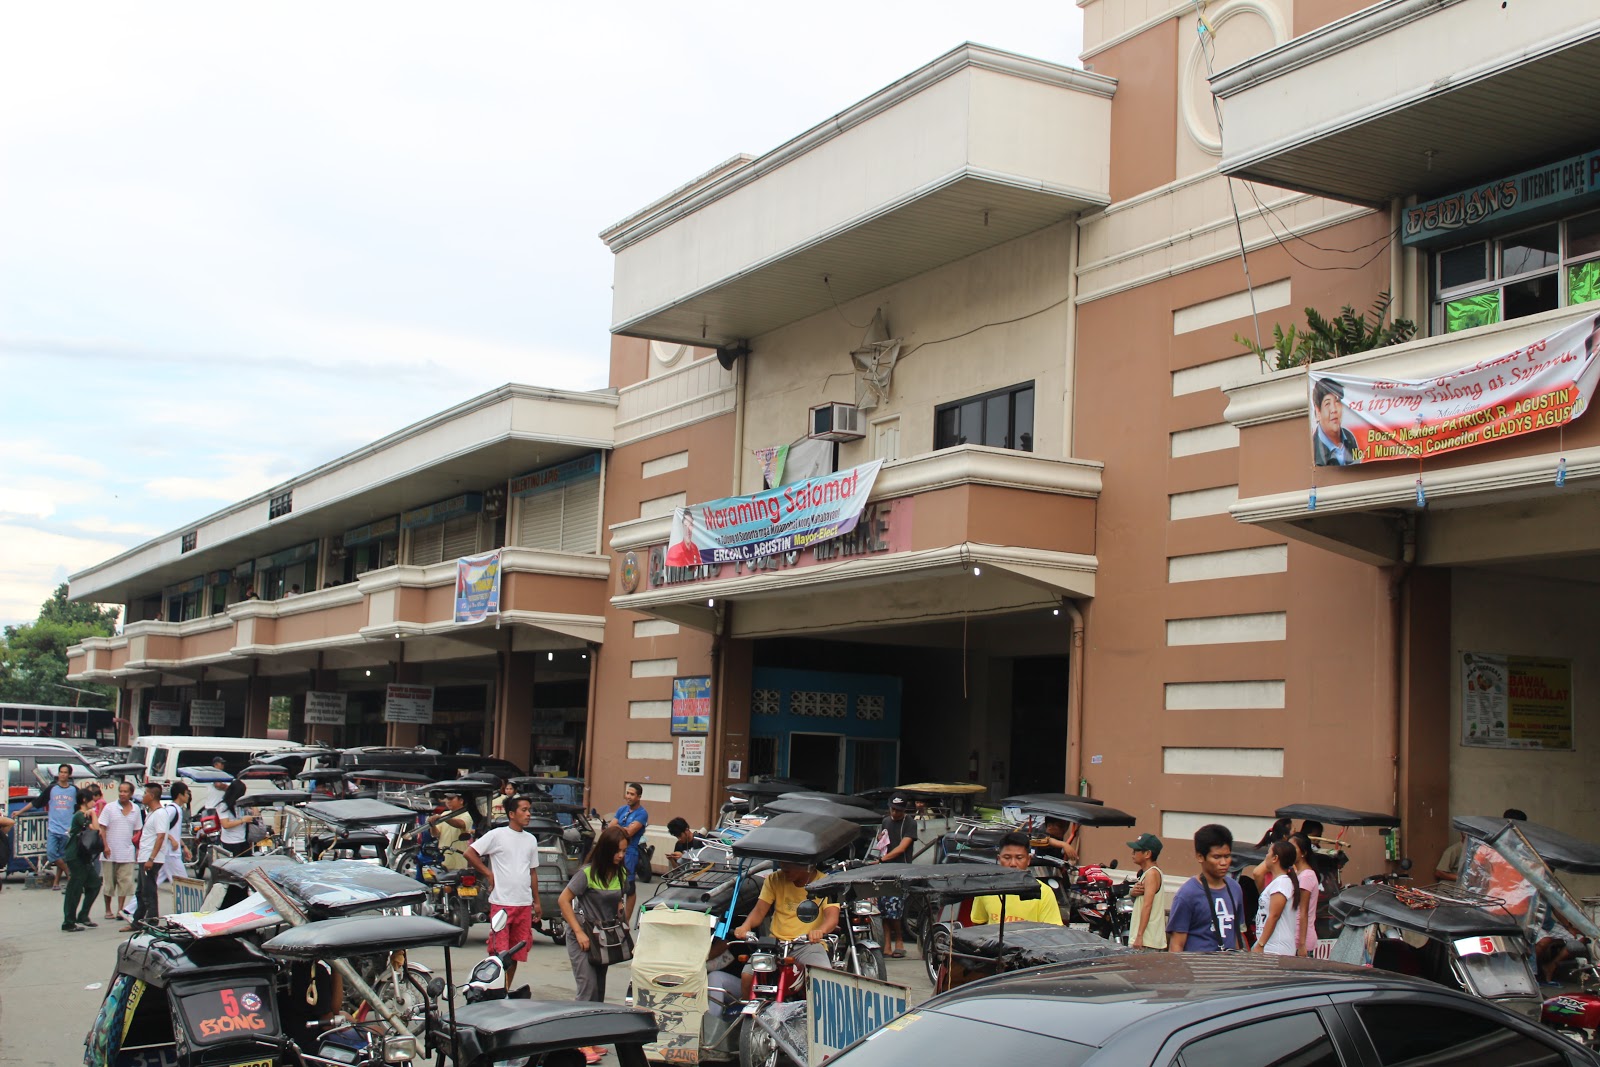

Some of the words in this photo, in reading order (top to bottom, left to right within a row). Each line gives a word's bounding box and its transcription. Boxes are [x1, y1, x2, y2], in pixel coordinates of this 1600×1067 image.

[1521, 167, 1561, 203] INTERNET
[1368, 394, 1423, 415] inyong
[1425, 383, 1483, 403] Tulong
[1488, 375, 1507, 391] at
[1436, 408, 1460, 420] Mula
[1462, 403, 1480, 416] kina
[1441, 408, 1496, 433] PATRICK
[1496, 405, 1511, 419] R.
[1513, 388, 1570, 415] AGUSTIN
[1374, 442, 1423, 458] Municipal
[1425, 431, 1480, 454] Councilor
[1481, 414, 1533, 440] GLADYS
[1535, 397, 1586, 428] AGUSTIN
[702, 494, 781, 531] Maraming
[784, 468, 859, 514] Salamat
[743, 546, 753, 559] C.
[754, 537, 791, 556] AGUSTIN
[793, 524, 839, 547] Mayor-Elect
[1508, 675, 1548, 689] BAWAL
[80, 780, 115, 790] LODING
[1214, 897, 1228, 916] A
[1216, 914, 1234, 938] F
[1478, 937, 1494, 953] 5
[219, 988, 240, 1017] 5
[812, 977, 894, 1050] PINDANGAN
[1557, 995, 1589, 1011] TMX
[199, 1012, 266, 1037] BONG
